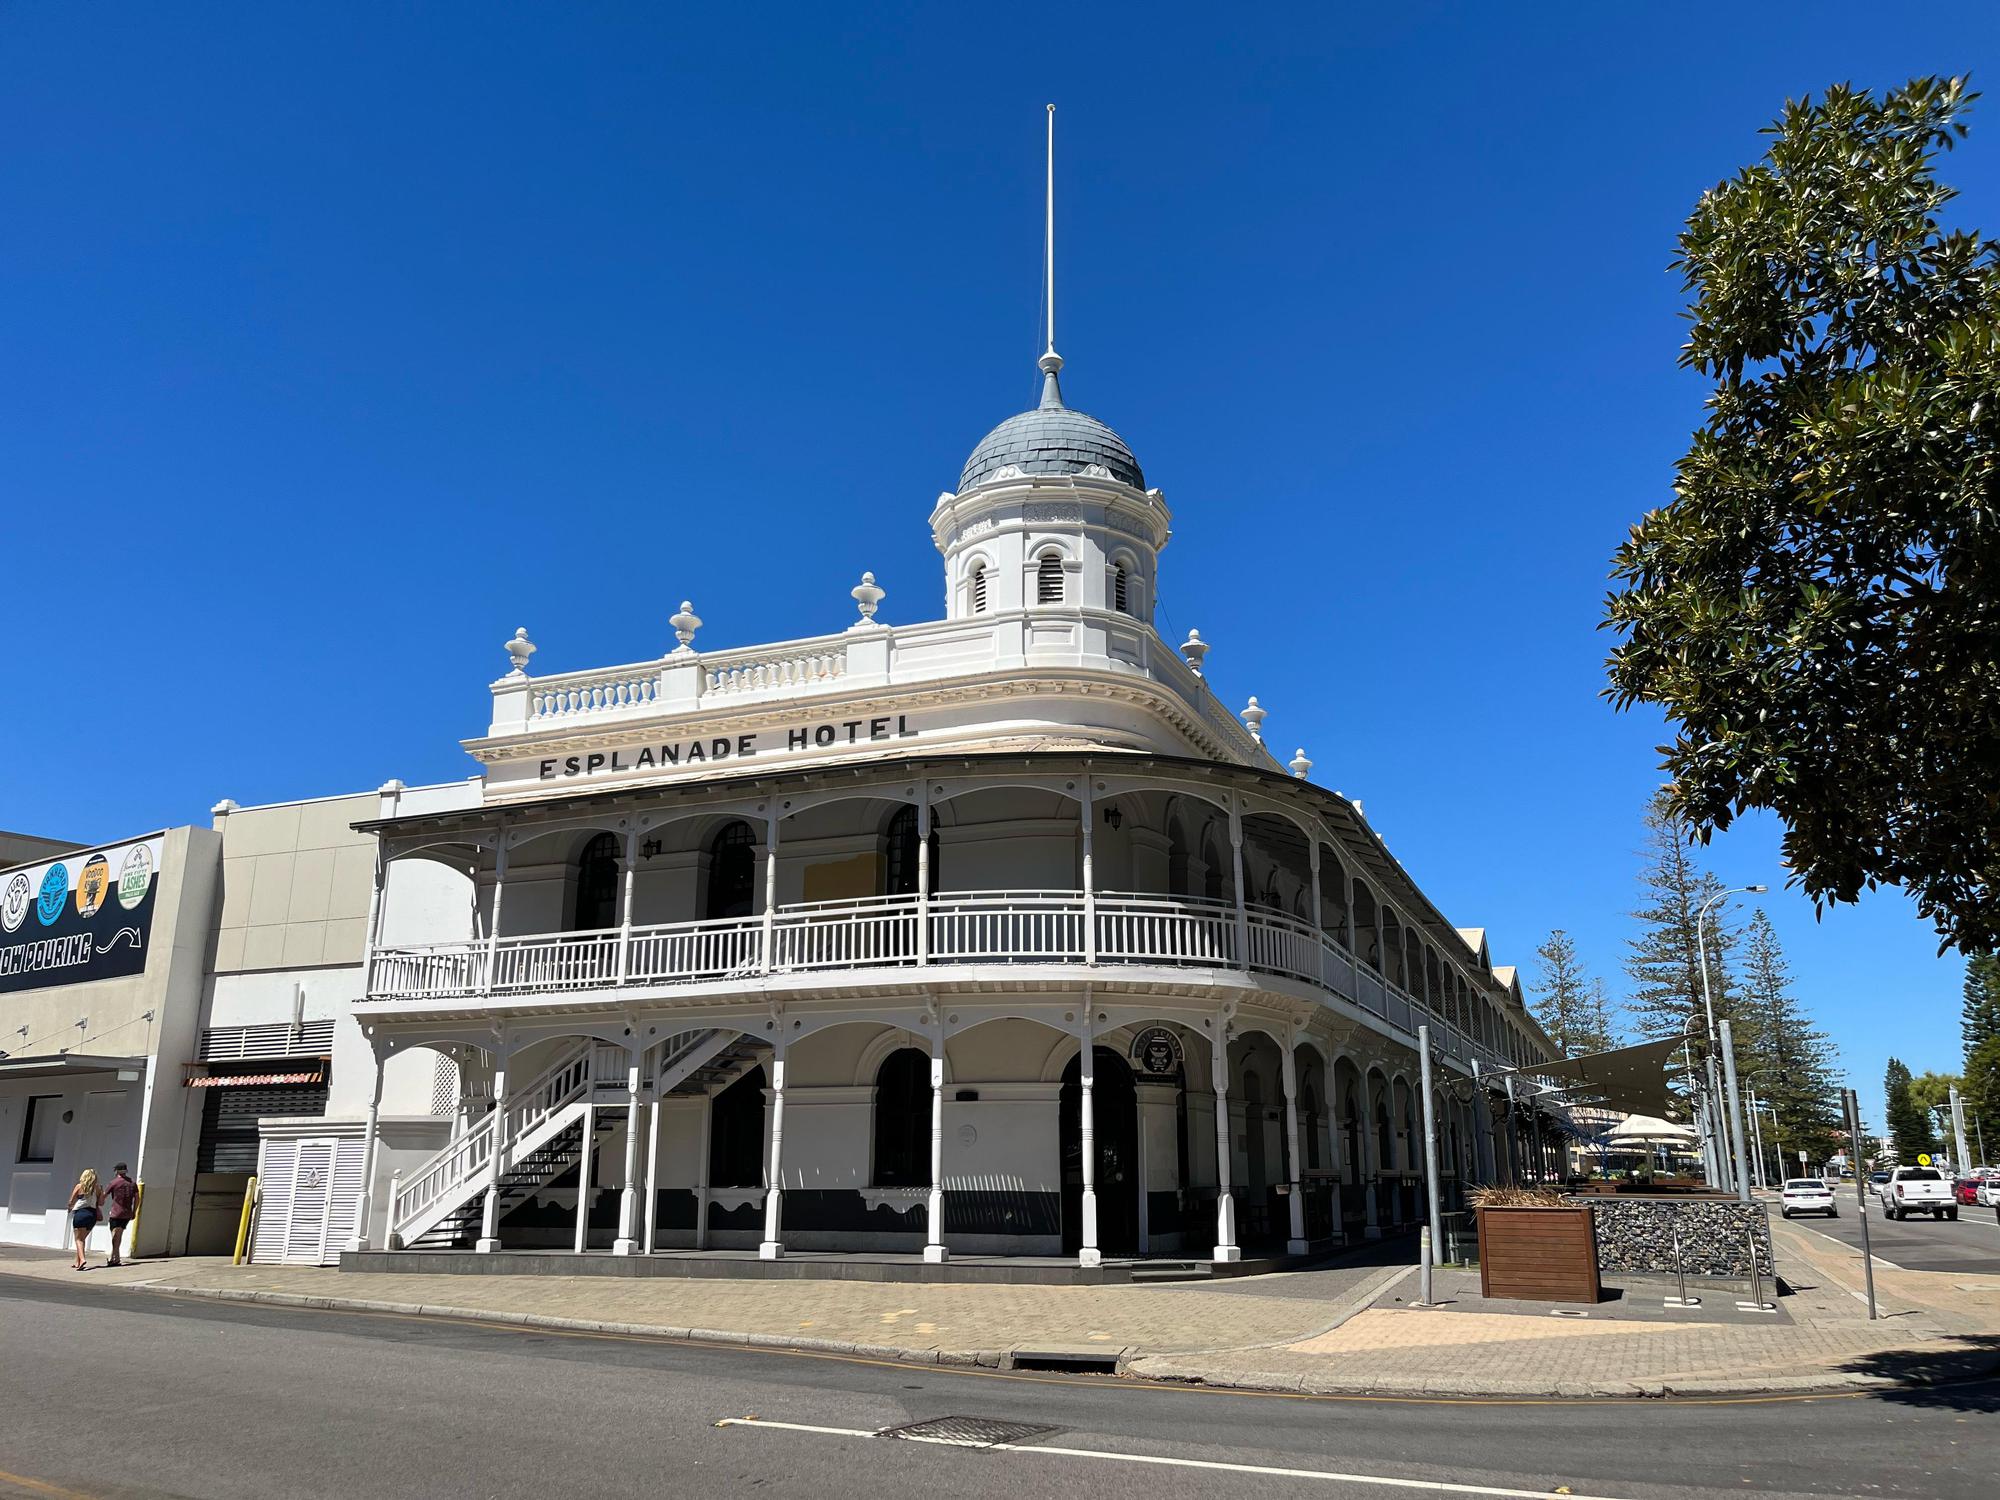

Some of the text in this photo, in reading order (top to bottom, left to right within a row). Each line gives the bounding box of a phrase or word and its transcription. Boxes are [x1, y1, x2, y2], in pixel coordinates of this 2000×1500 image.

[540, 715, 919, 781] ESPLANADE HOTEL
[8, 877, 28, 898] FURPHY
[122, 873, 147, 892] LASHES
[0, 932, 93, 976] OW POURING
